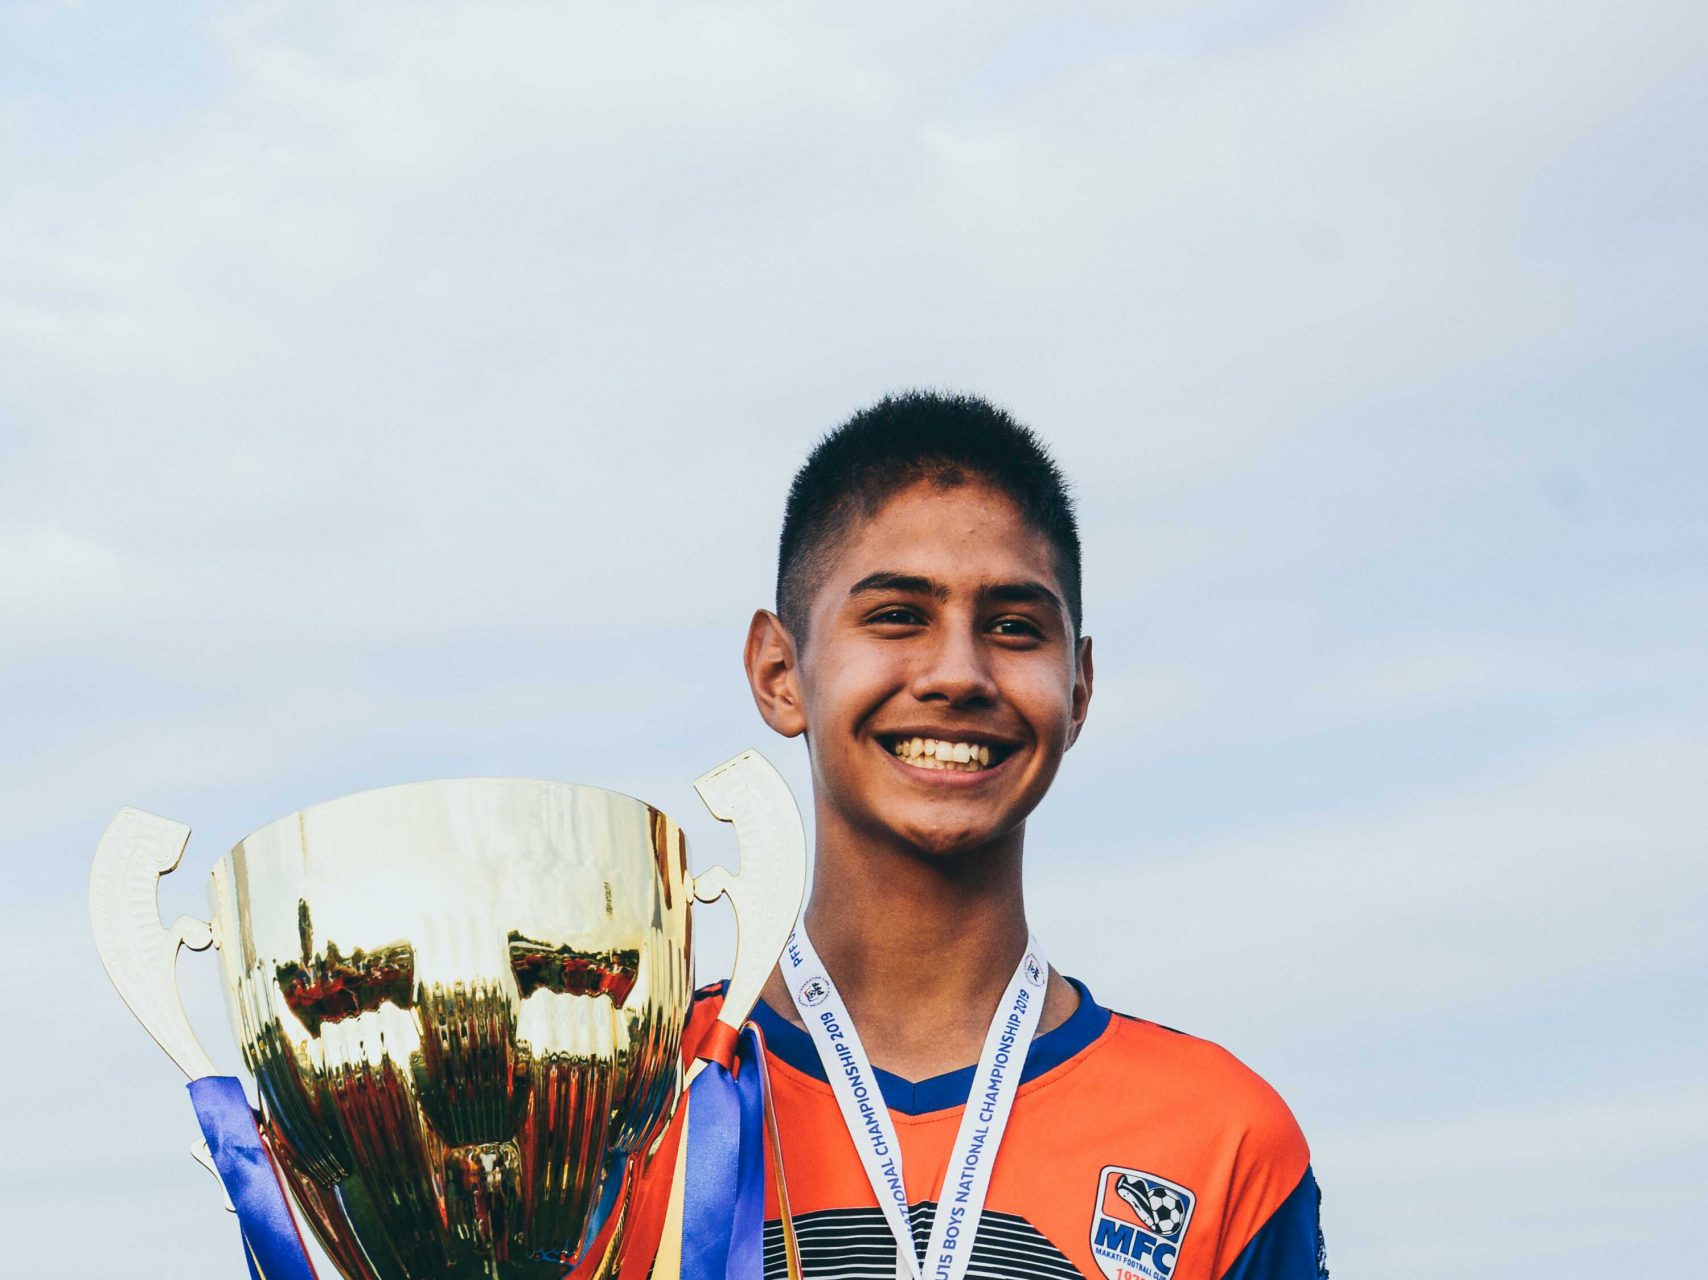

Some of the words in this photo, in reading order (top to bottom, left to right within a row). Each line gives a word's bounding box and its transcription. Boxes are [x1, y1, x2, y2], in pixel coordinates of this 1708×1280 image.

[788, 944, 804, 968] PFF
[820, 1012, 844, 1041] 2019
[835, 1043, 889, 1156] CHAMPIONSHIP
[943, 1207, 966, 1250] BOYS
[955, 1126, 990, 1204] NATIONAL
[980, 1013, 1022, 1123] CHAMPIONSHIP
[1014, 988, 1030, 1015] 2019
[1094, 1217, 1177, 1276] MFC
[1095, 1247, 1122, 1262] MAKATI
[1123, 1258, 1152, 1277] FOOTBALL
